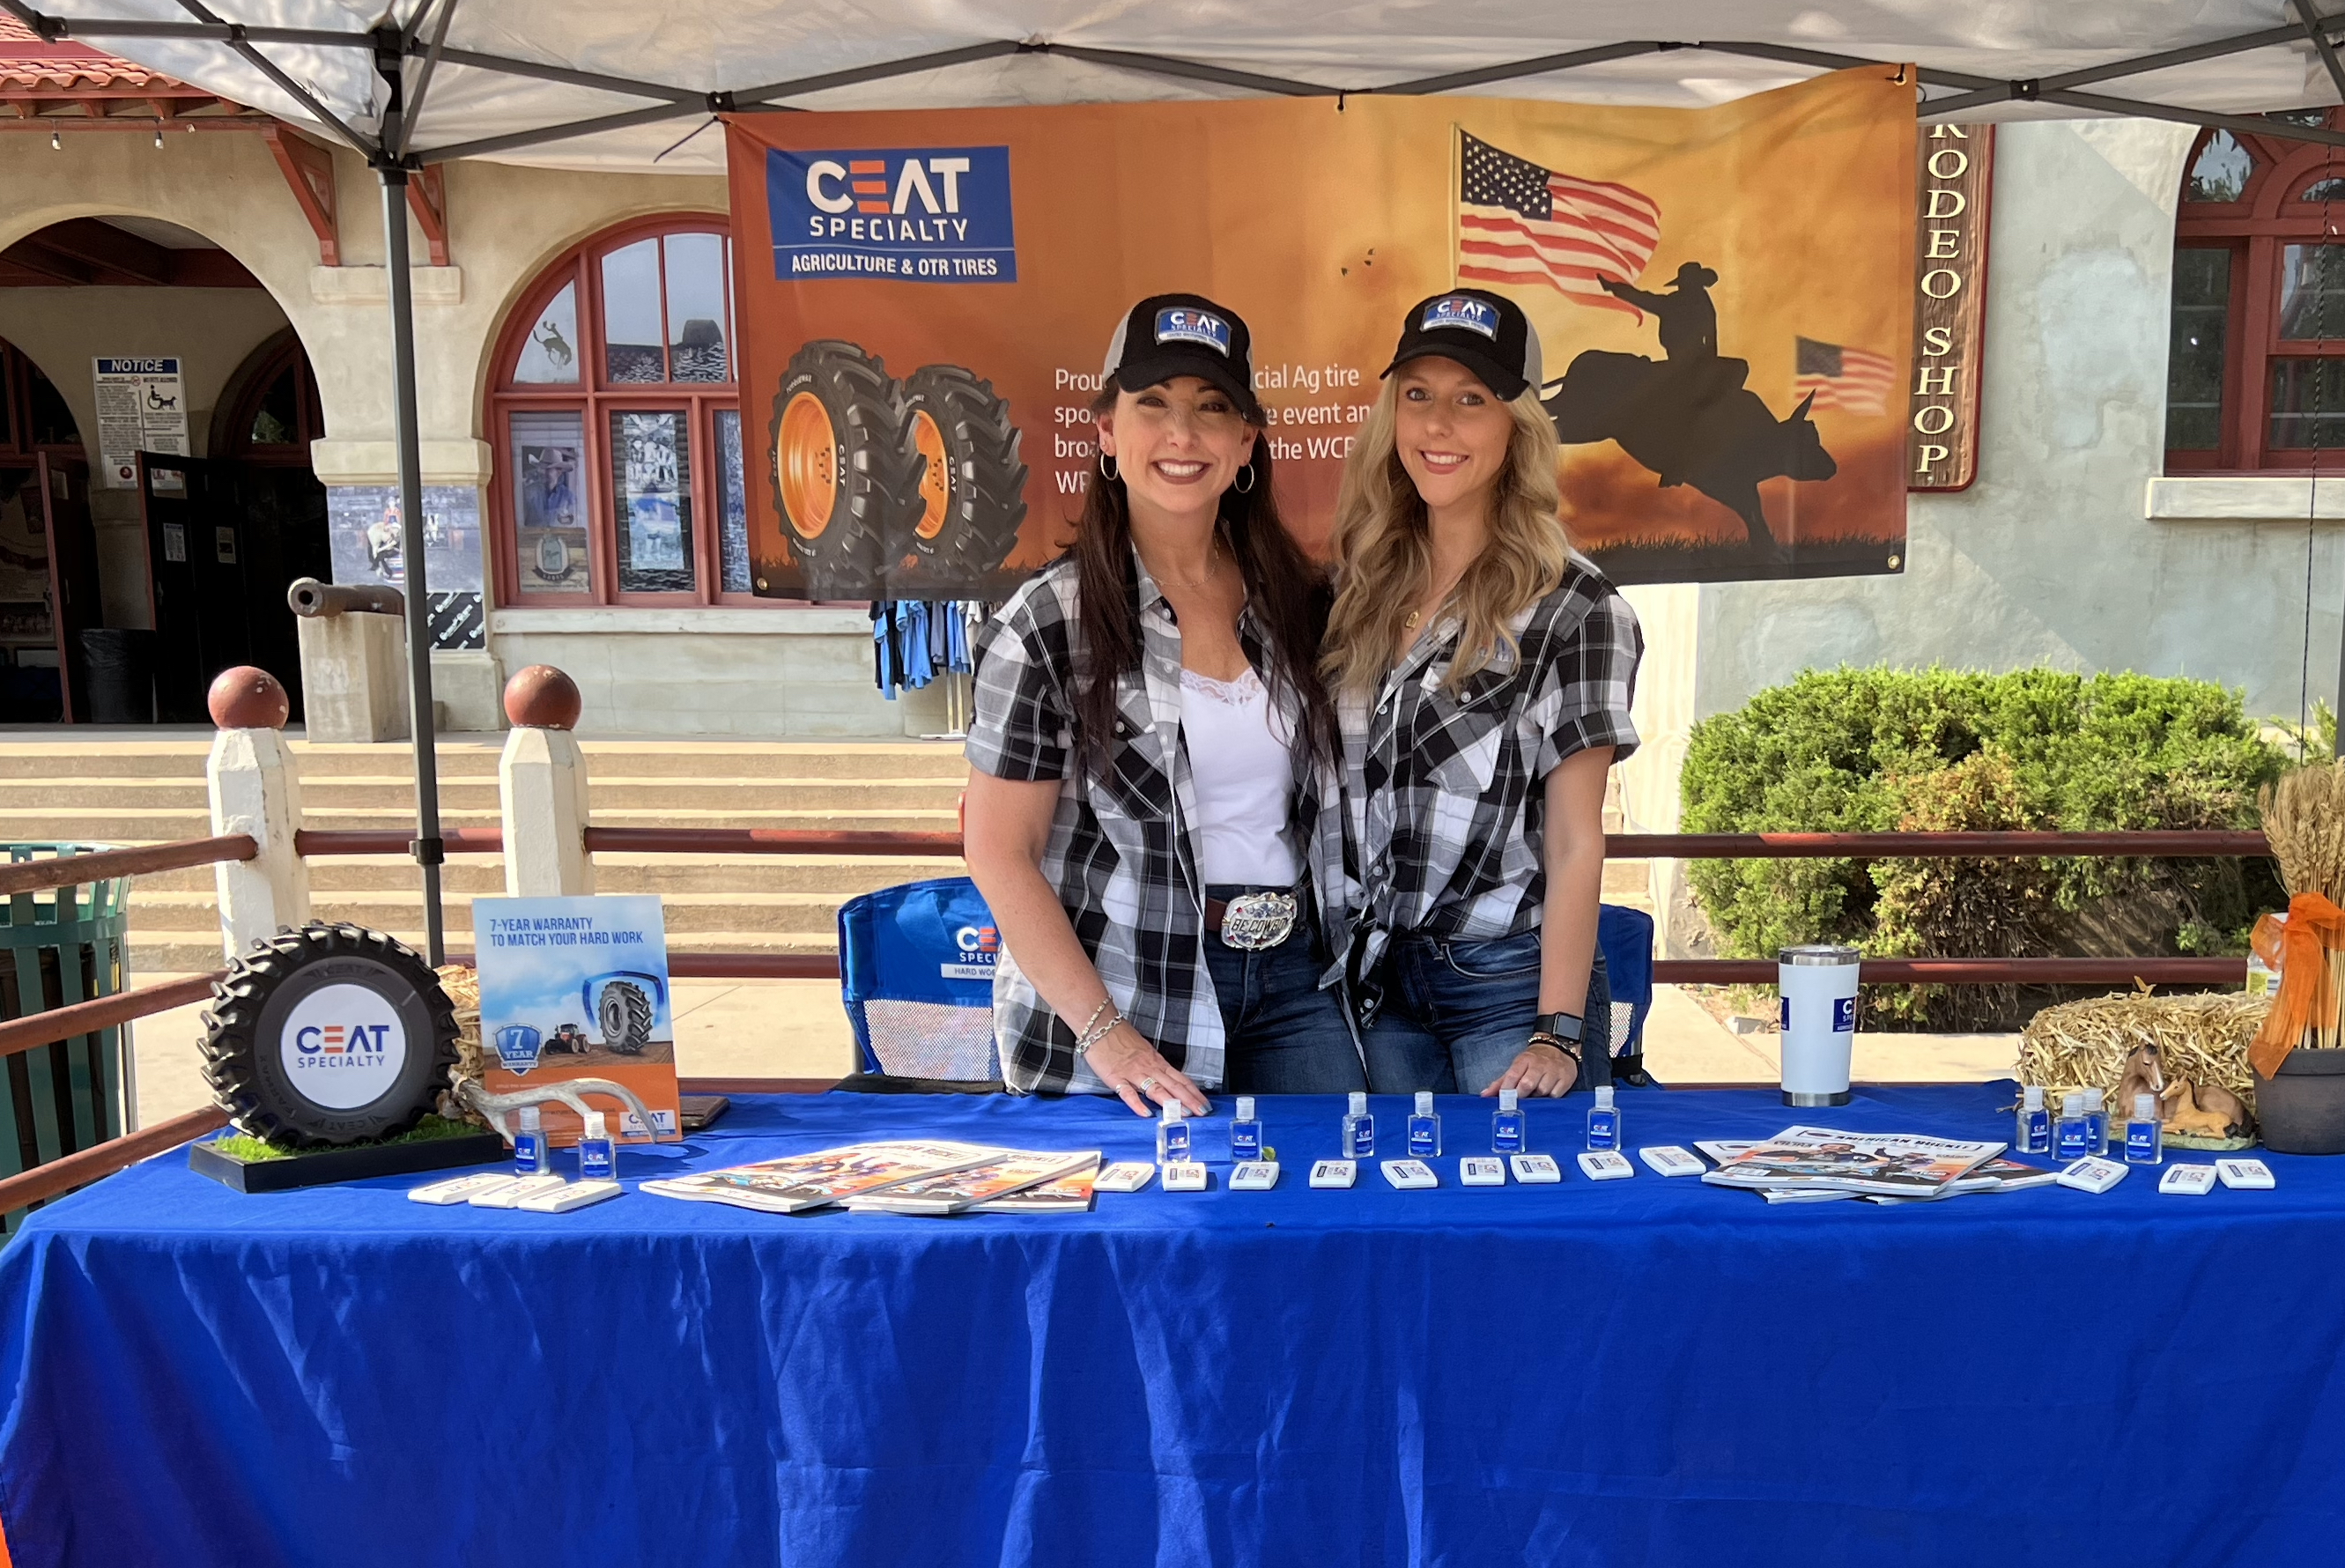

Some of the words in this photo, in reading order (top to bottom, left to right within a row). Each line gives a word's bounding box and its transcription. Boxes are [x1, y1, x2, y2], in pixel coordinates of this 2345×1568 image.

[806, 157, 970, 214] CEAT
[810, 216, 968, 241] SPECIALTY
[792, 254, 897, 274] AGRICULTURE
[900, 259, 914, 275] &
[918, 258, 949, 276] OTR
[952, 258, 997, 276] TIRES
[1437, 300, 1487, 317] CEAT
[1170, 311, 1220, 332] CEAT
[111, 359, 164, 372] NOTICE
[1055, 368, 1103, 391] Prou
[1254, 363, 1288, 389] cial
[1292, 365, 1320, 395] Ag
[1324, 363, 1359, 388] tire
[1913, 327, 1957, 473] SHOP
[1283, 402, 1342, 425] event
[1345, 404, 1371, 423] an
[1269, 436, 1303, 460] the
[490, 918, 529, 932] 7-YEAR
[533, 917, 593, 931] WARRANTY
[491, 934, 505, 947] TO
[507, 933, 546, 946] MATCH
[548, 932, 577, 945] YOUR
[580, 931, 610, 944] HARD
[611, 931, 644, 944] WORK
[957, 927, 998, 952] CE
[296, 1024, 390, 1054] CEAT
[510, 1029, 524, 1049] 7
[298, 1055, 386, 1069] SPECIALTY
[504, 1050, 534, 1059] YEAR
